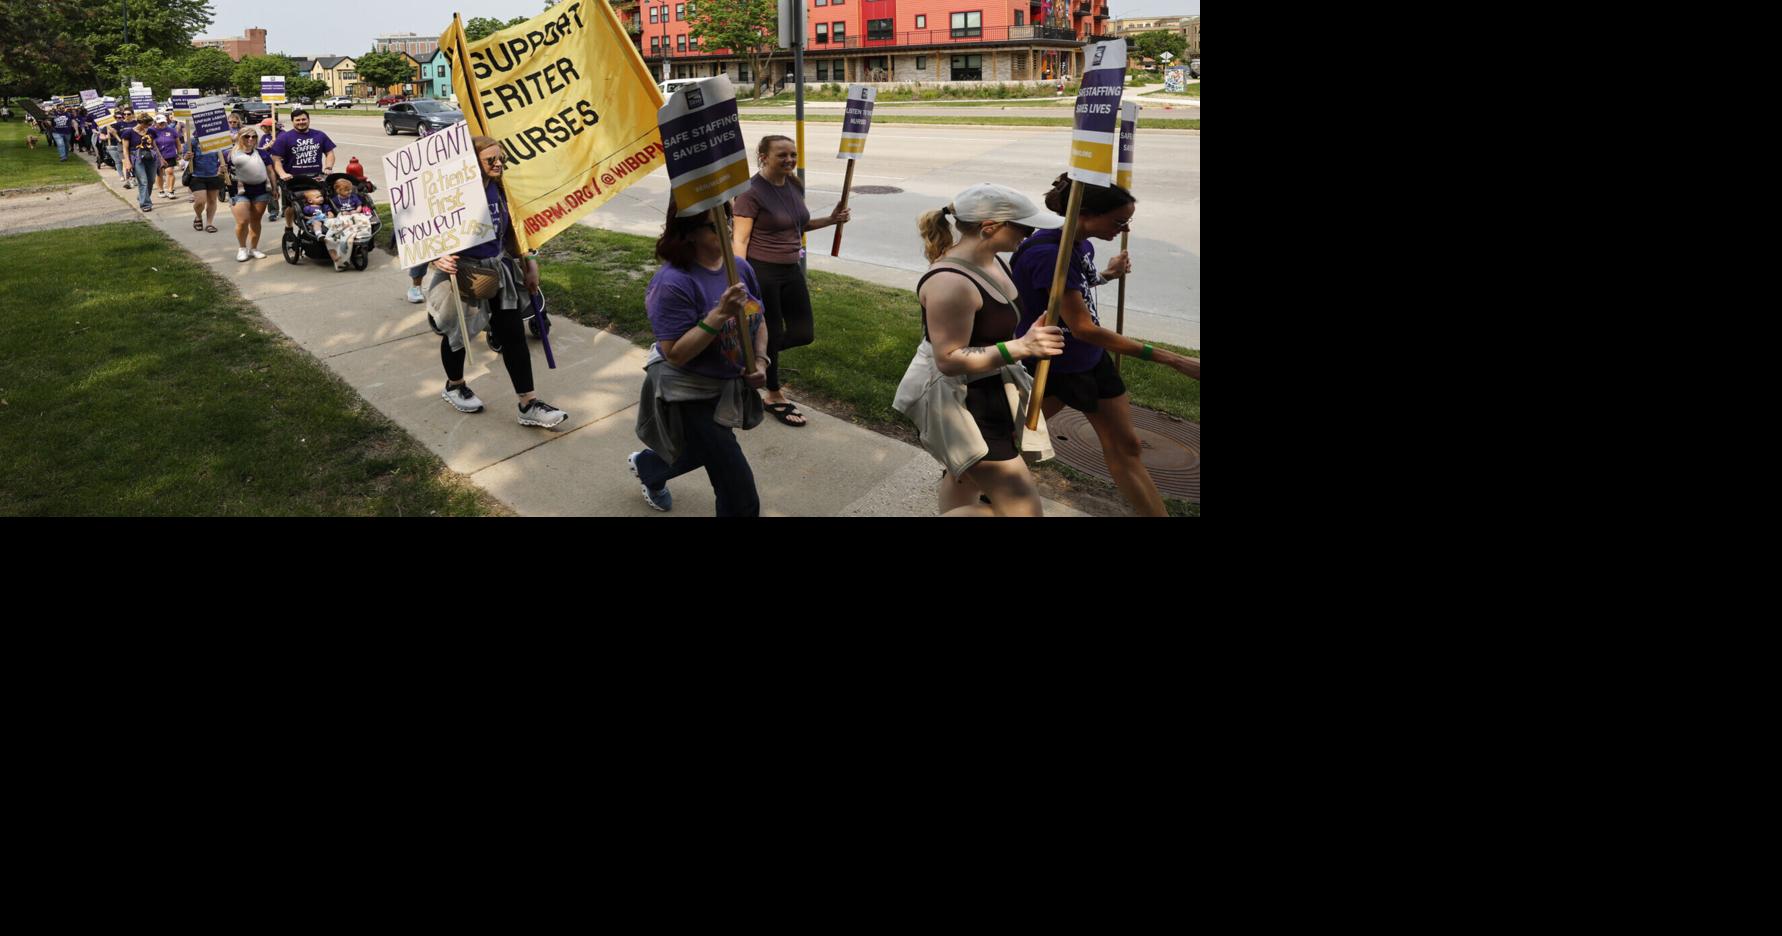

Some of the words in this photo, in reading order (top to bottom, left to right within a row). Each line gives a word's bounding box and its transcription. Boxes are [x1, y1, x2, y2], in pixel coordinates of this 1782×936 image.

[470, 2, 583, 80] SUPPORT
[480, 57, 580, 119] ERITER
[1085, 86, 1121, 97] STAFFING
[1089, 103, 1112, 114] LIVES
[296, 138, 314, 147] SAFE
[664, 131, 689, 149] SAFE
[691, 113, 739, 138] STAFFING
[673, 141, 708, 161] SAVES
[710, 130, 736, 147] LIVES
[291, 143, 320, 154] STAFFING
[295, 150, 317, 160] SAVES
[296, 156, 317, 165] LIVES
[386, 143, 422, 181] YOU
[390, 176, 419, 214] PUT
[421, 160, 477, 198] Patients
[408, 220, 432, 244] YOU
[434, 207, 466, 234] PUT
